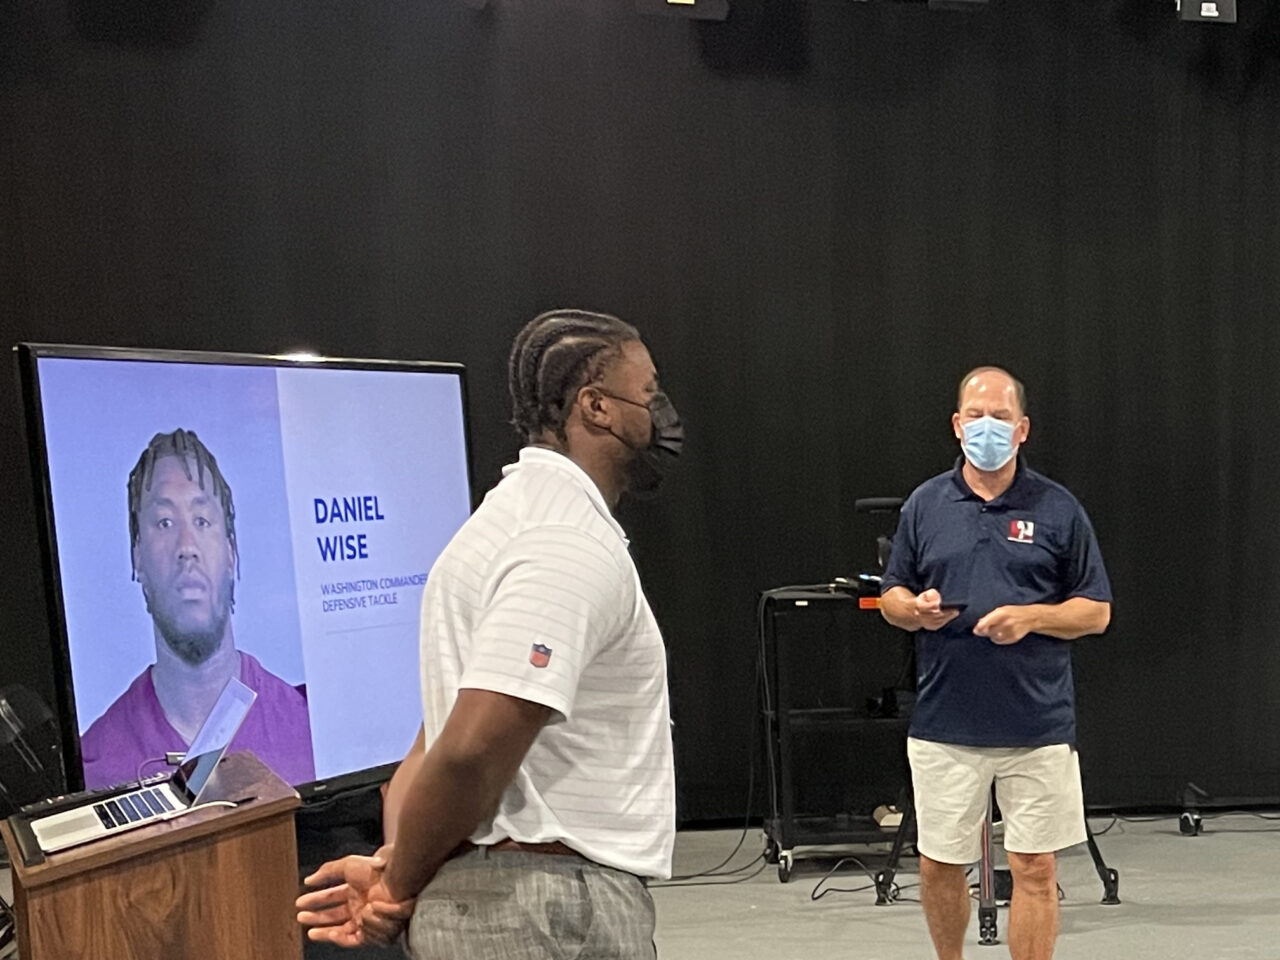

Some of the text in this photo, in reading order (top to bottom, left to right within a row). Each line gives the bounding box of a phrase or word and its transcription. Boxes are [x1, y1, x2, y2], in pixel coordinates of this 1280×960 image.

[314, 496, 385, 524] DANIEL
[317, 534, 369, 562] WISE
[320, 579, 378, 595] WASHINGTON
[322, 592, 398, 612] DEFENSIVE TACKLE
